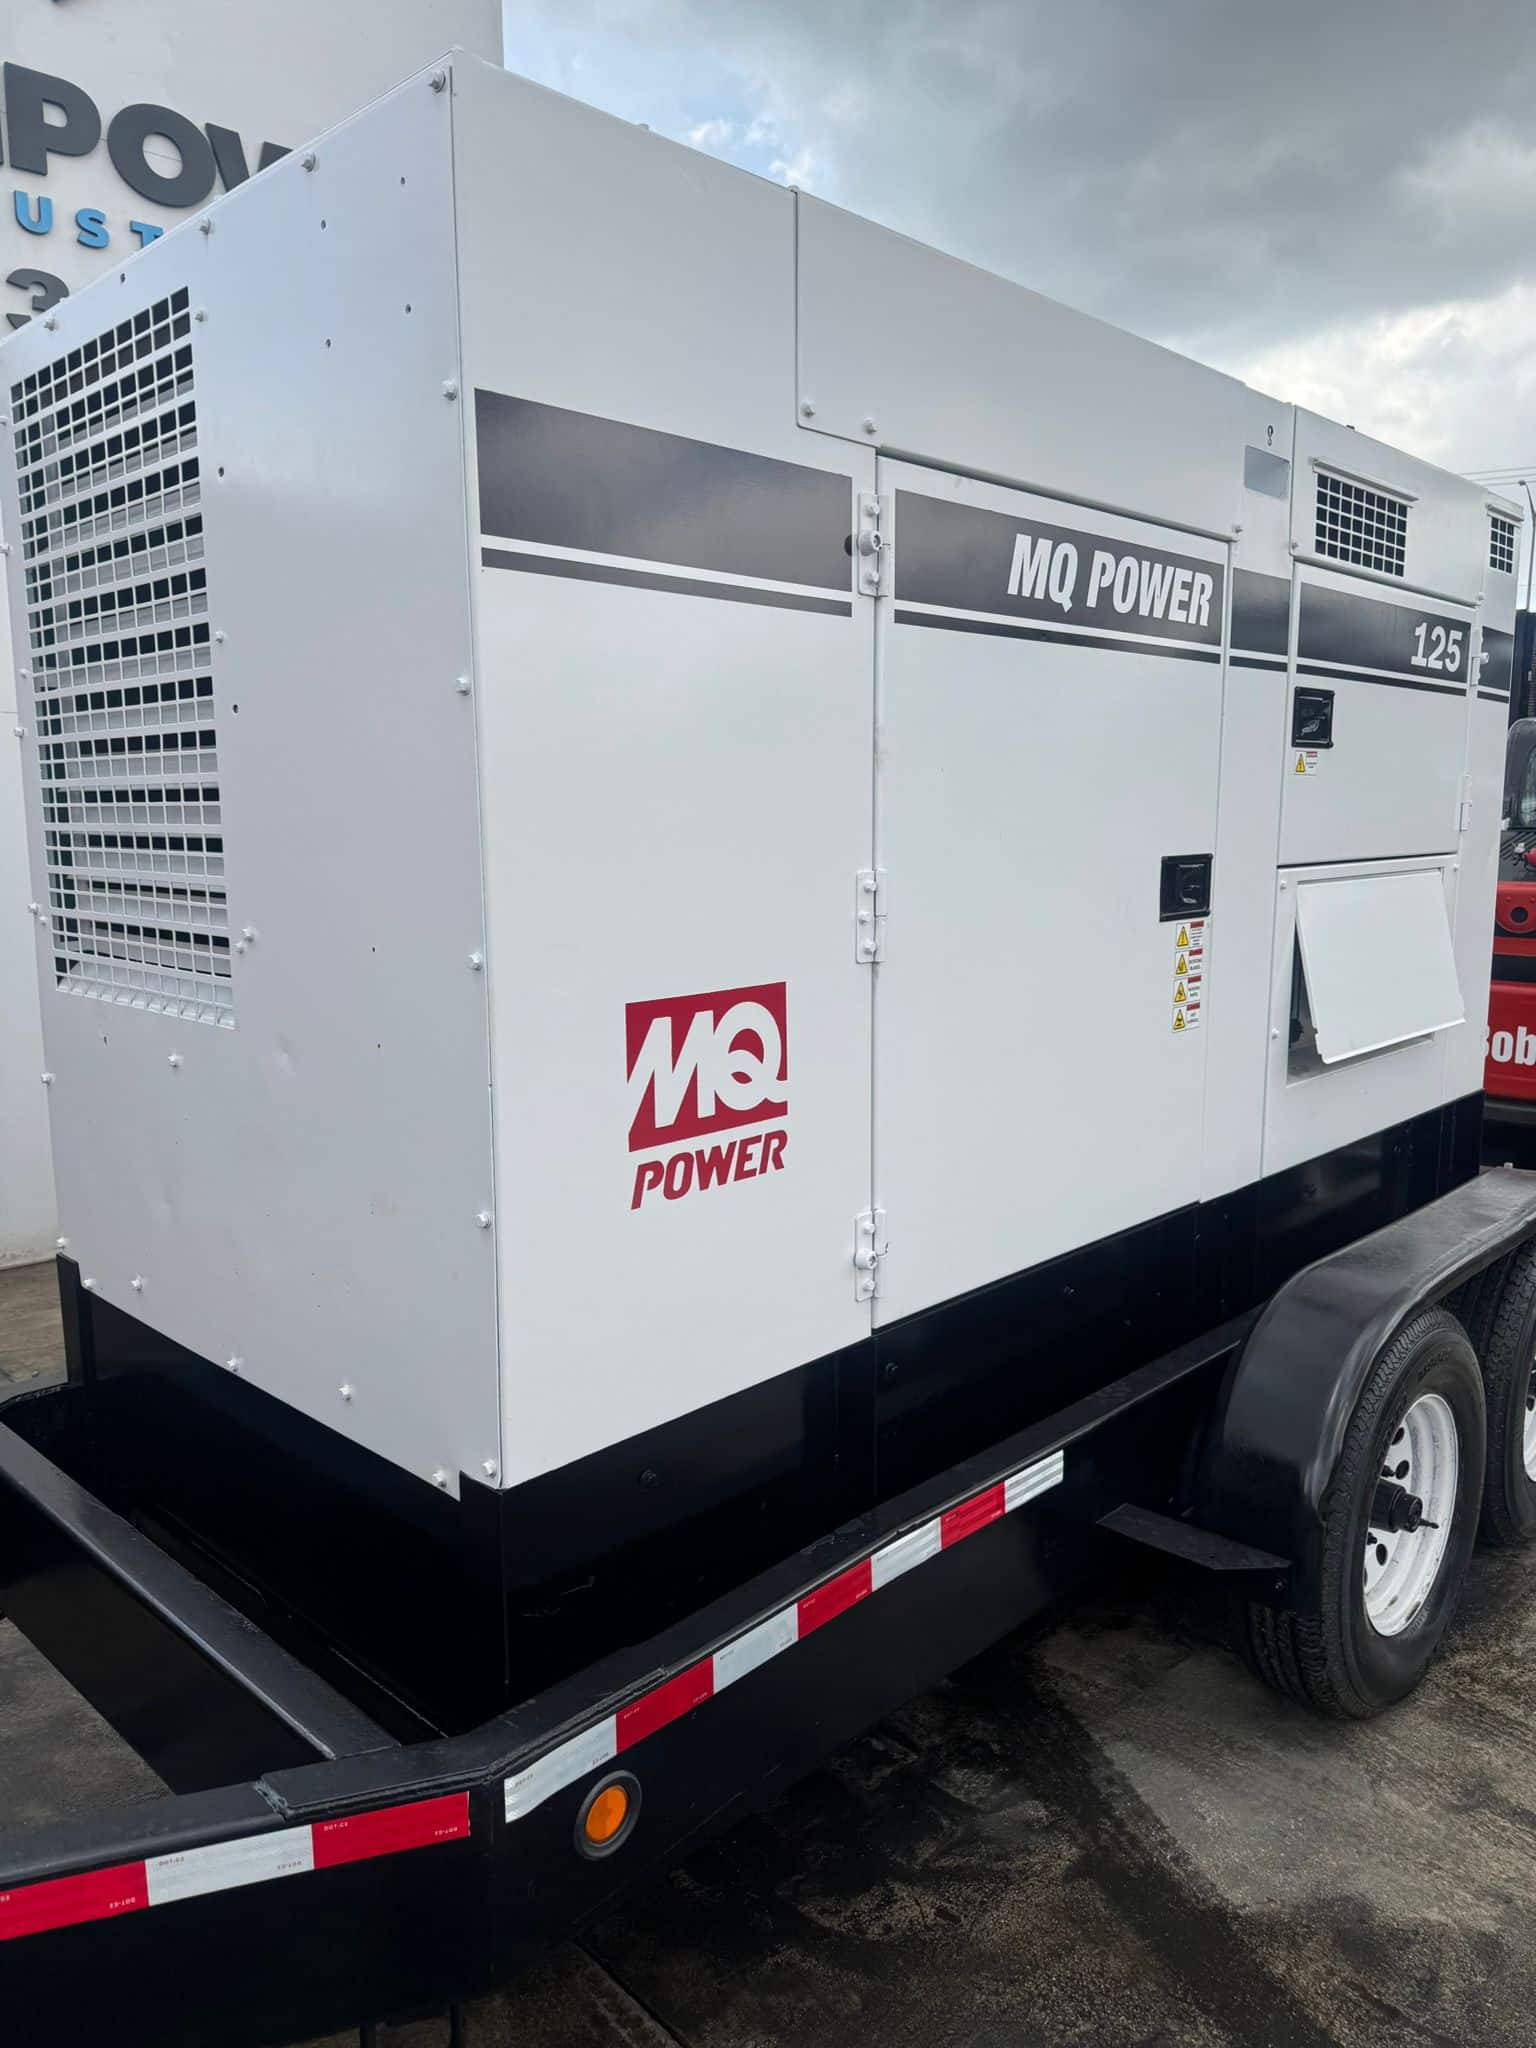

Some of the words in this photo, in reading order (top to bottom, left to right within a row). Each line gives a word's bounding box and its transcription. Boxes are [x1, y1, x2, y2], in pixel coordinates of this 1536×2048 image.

[1007, 533, 1079, 613] MQ
[1086, 550, 1214, 627] POWER
[1410, 622, 1463, 672] 125
[626, 999, 788, 1130] MQ
[1484, 1025, 1536, 1066] ob
[630, 1129, 788, 1210] POWER
